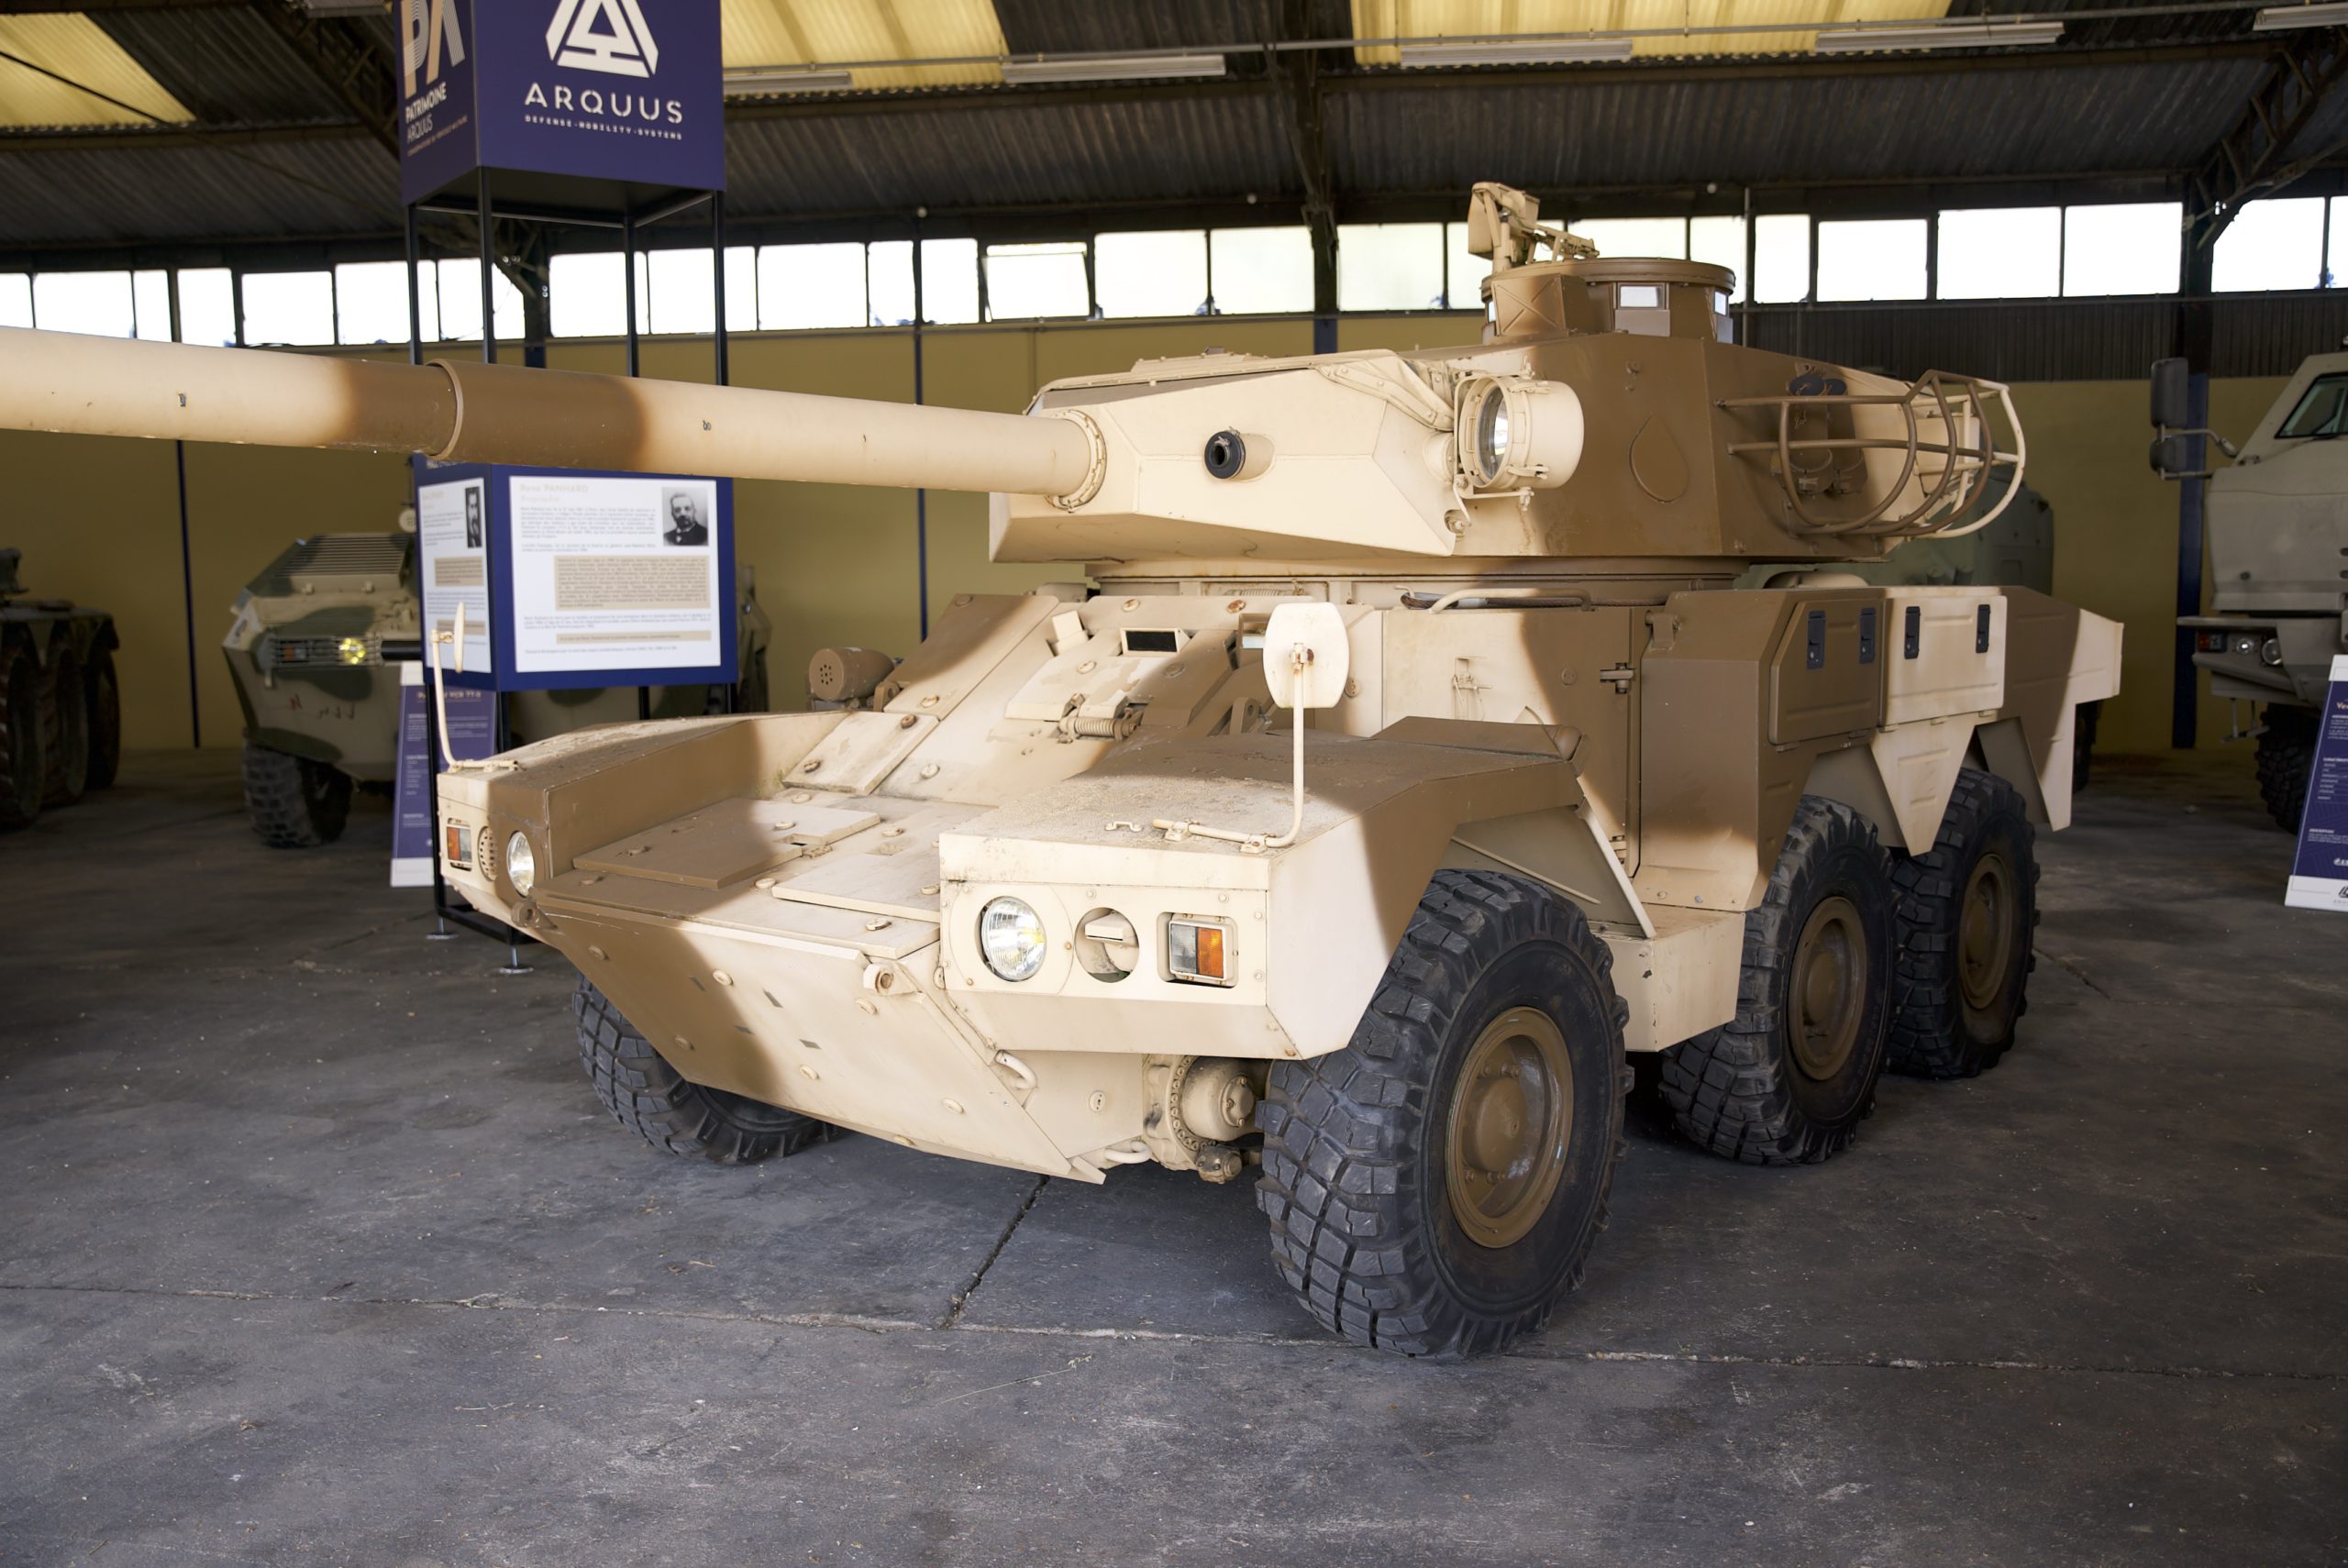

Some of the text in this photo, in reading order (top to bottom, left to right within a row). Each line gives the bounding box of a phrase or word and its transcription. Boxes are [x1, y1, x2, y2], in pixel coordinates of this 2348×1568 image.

[405, 81, 448, 124] PATRIMOINE
[524, 82, 683, 124] ARQUUS
[407, 112, 434, 144] ARQUUS
[543, 483, 589, 493] PANHARD
